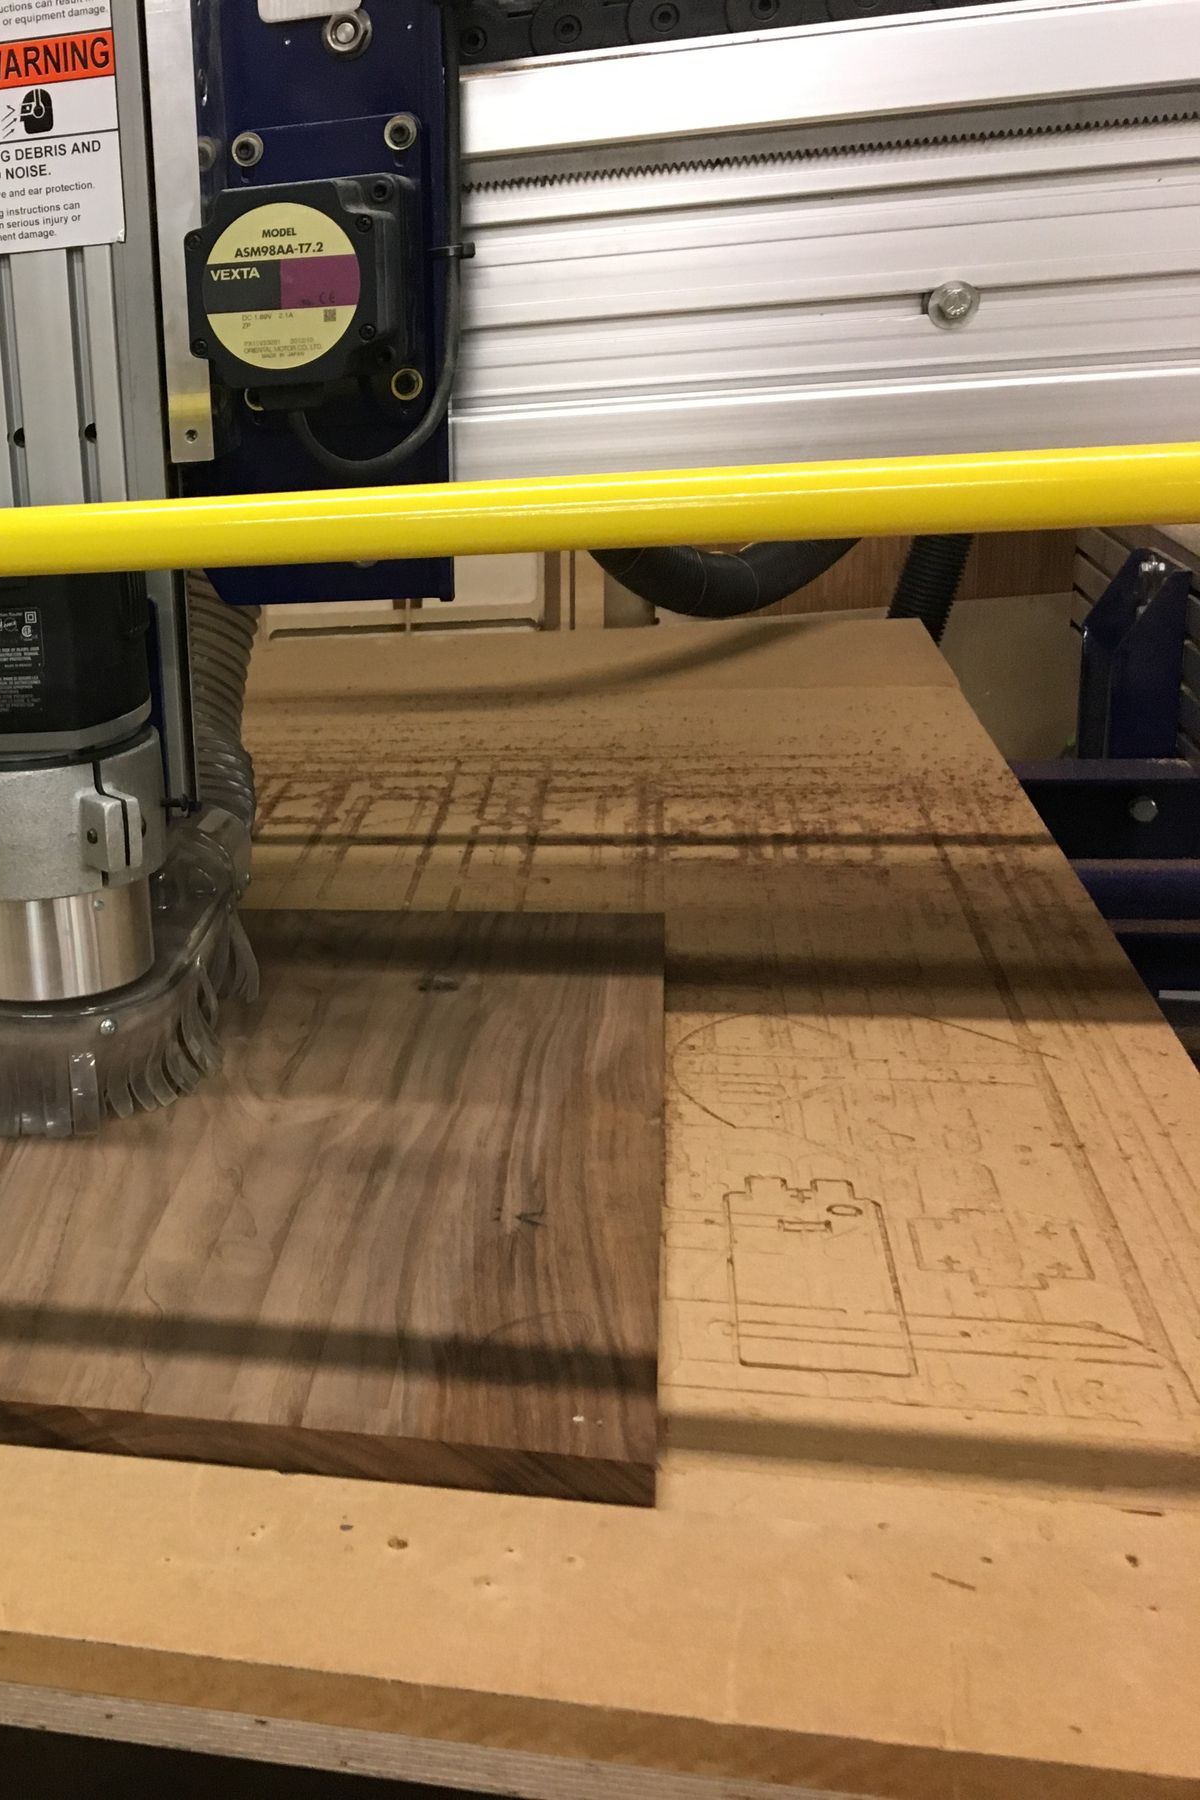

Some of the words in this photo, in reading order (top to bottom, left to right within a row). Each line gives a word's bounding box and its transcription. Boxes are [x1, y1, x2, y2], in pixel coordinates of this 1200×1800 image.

[35, 0, 52, 9] can
[2, 18, 12, 26] or
[15, 10, 65, 25] equipment
[15, 143, 67, 161] DEBRIS
[71, 140, 101, 155] AND
[5, 164, 51, 180] NOISE.
[9, 188, 25, 198] and
[28, 188, 42, 196] ear
[45, 182, 95, 196] protection.
[6, 203, 61, 216] instructions
[63, 202, 80, 210] can
[6, 218, 40, 229] serious
[42, 216, 69, 226] injury
[71, 214, 81, 222] or
[18, 229, 56, 240] damage.
[261, 227, 297, 238] MODEL
[234, 242, 324, 258] ASM98AA-T7.2
[210, 267, 260, 281] VEXTA
